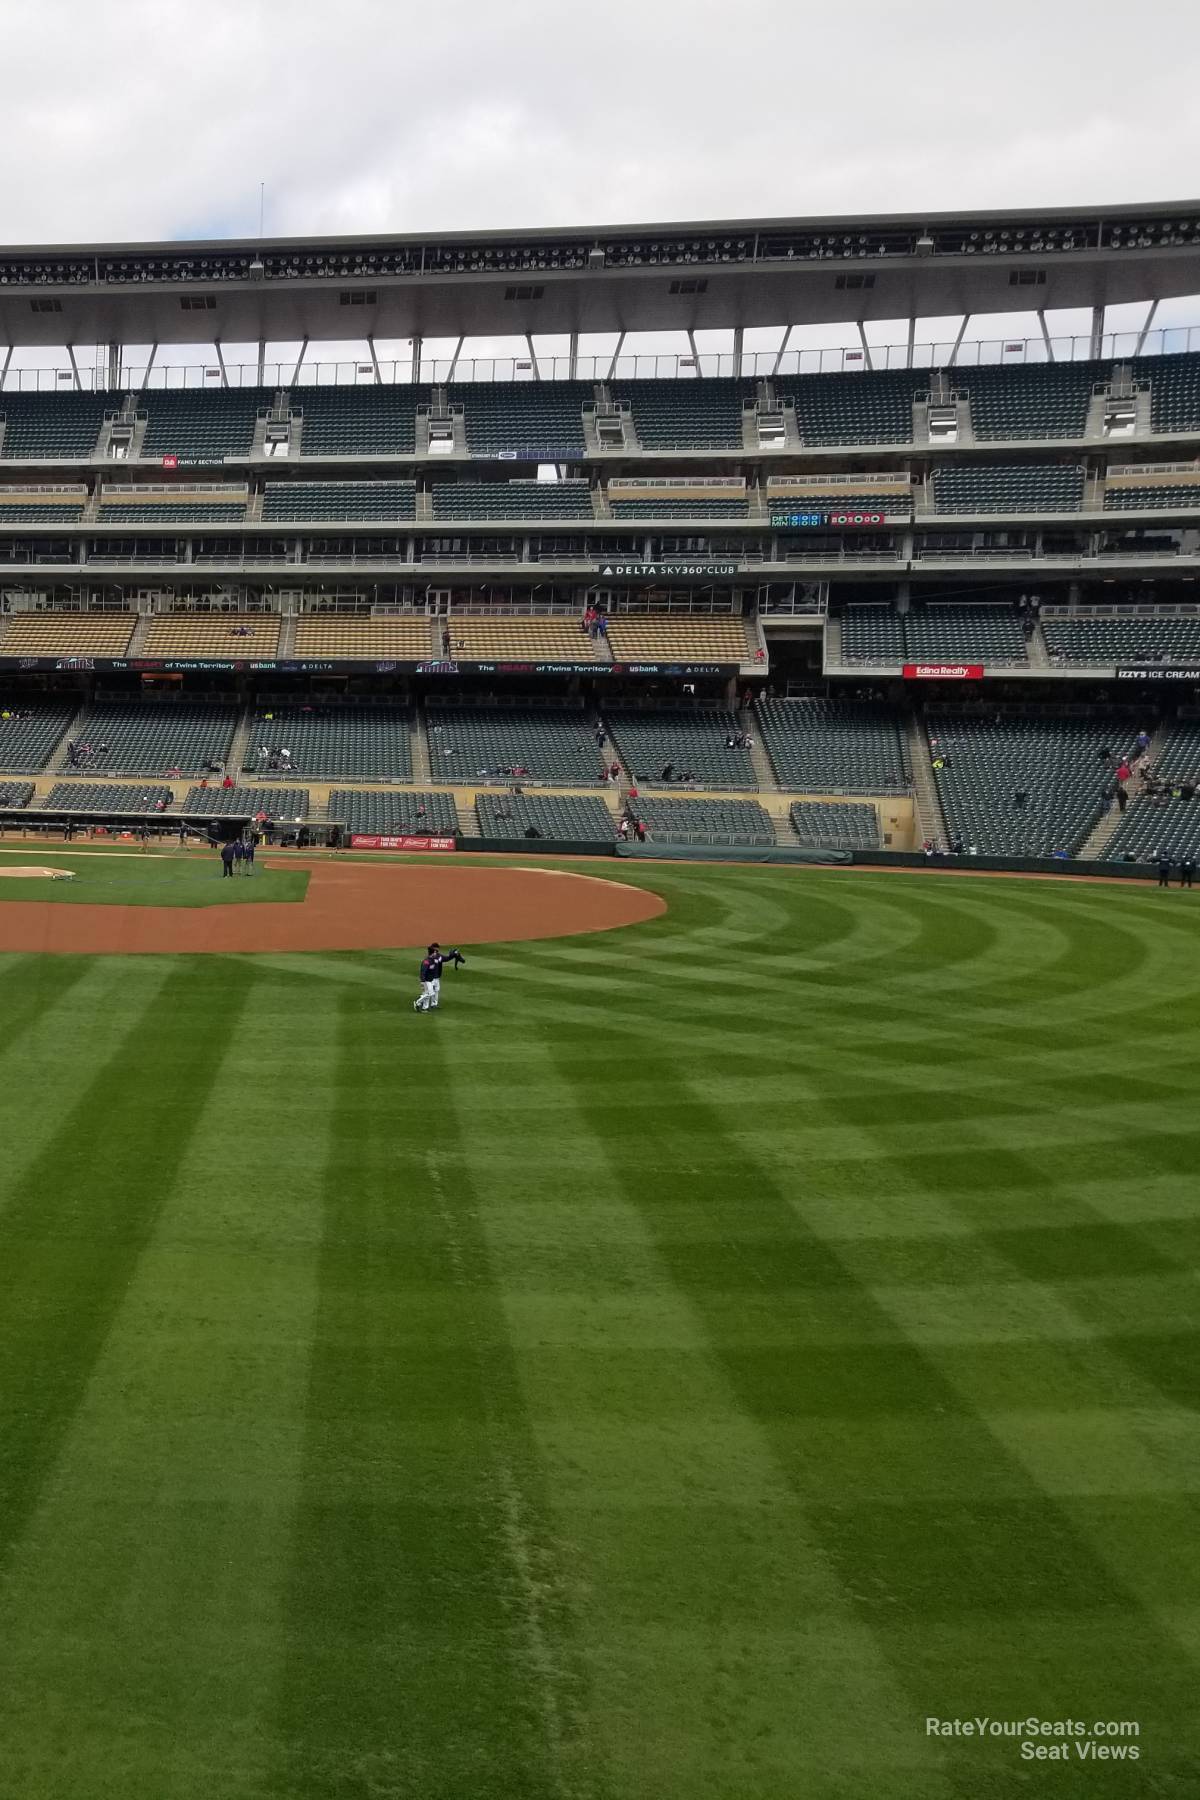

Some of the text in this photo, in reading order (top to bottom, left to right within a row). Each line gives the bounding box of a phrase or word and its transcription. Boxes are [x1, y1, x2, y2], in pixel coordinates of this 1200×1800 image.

[616, 566, 657, 574] DELTA
[200, 662, 236, 670] Territory
[535, 664, 546, 672] of
[573, 665, 613, 674] Territory
[629, 665, 659, 673] usbank
[916, 666, 940, 675] Edina
[1118, 670, 1200, 679] IZZY'S ICE CREAM
